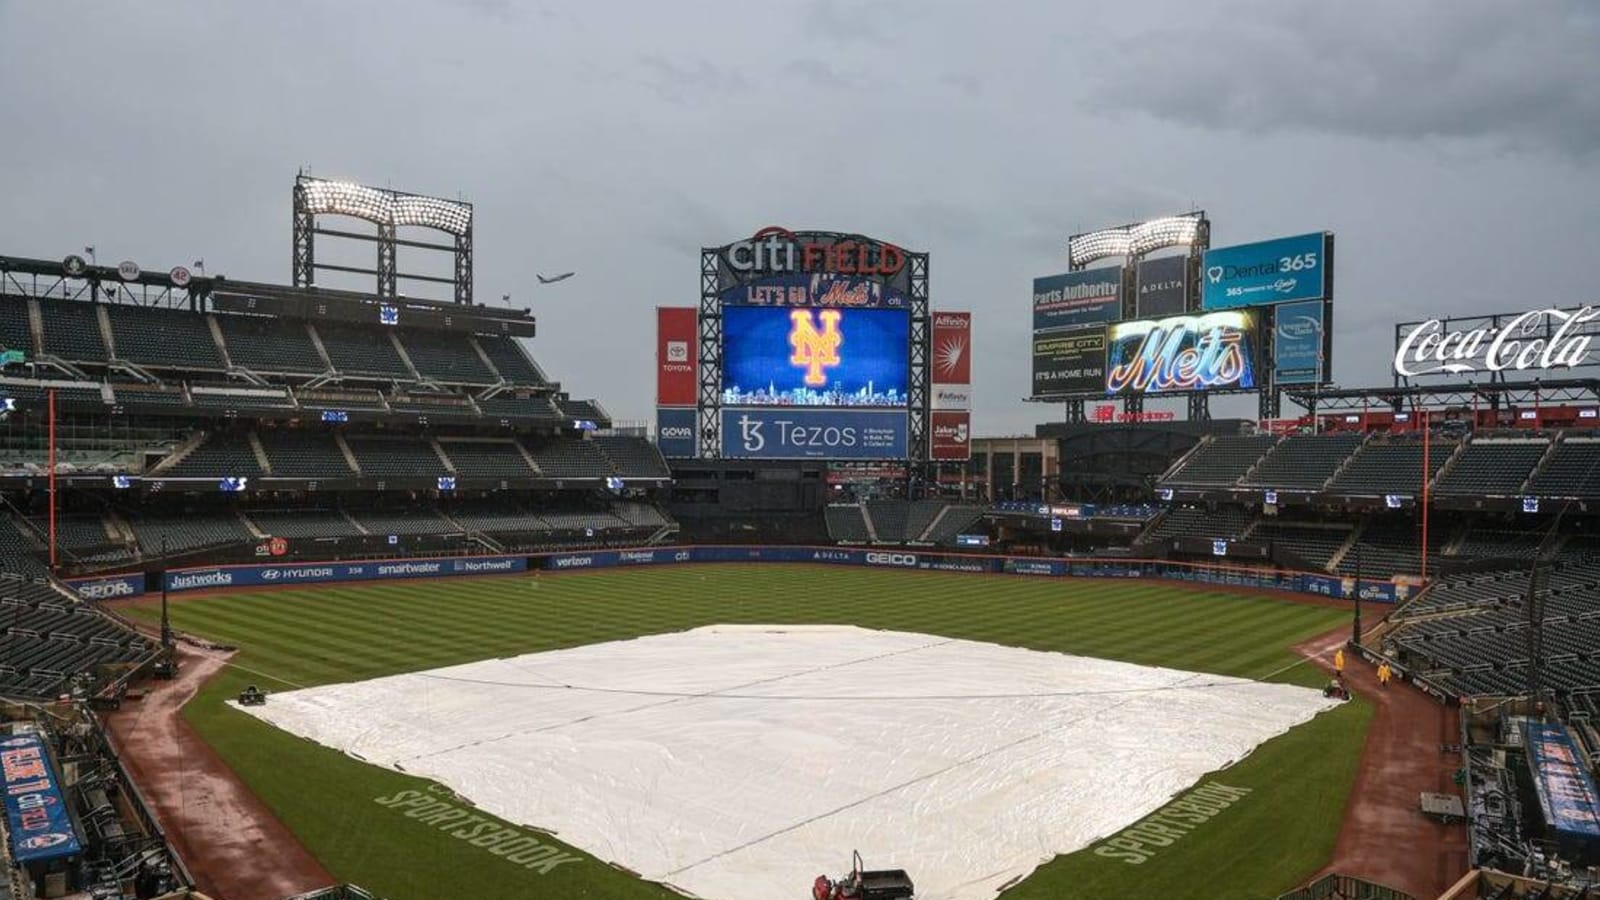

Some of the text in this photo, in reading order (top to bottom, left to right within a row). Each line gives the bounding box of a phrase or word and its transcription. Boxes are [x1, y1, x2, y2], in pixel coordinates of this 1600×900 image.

[729, 236, 904, 274] citi FIELD
[173, 271, 187, 281] 42
[1150, 280, 1183, 291] DELTA
[748, 286, 806, 304] LET'S GO
[1033, 289, 1061, 304] Parts
[1063, 282, 1119, 300] Authority
[935, 316, 969, 328] Affinity
[1037, 338, 1101, 352] EMPIRE CITY
[1108, 324, 1243, 392] Mets
[663, 364, 692, 372] TOYOTA
[1035, 368, 1102, 380] IT'S A HOME RUN
[661, 427, 692, 437] GOYA
[774, 421, 856, 446] Tezos
[822, 551, 849, 560] DELTA
[866, 551, 916, 566] GEICO
[465, 560, 513, 571] Northwell
[556, 557, 592, 567] verizon
[283, 567, 333, 578] HYUNDAI
[378, 563, 440, 575] smartwater
[171, 572, 232, 589] Justworks
[1094, 781, 1253, 865] SPORTSBOOK
[374, 790, 584, 876] SPORTSBOOK
